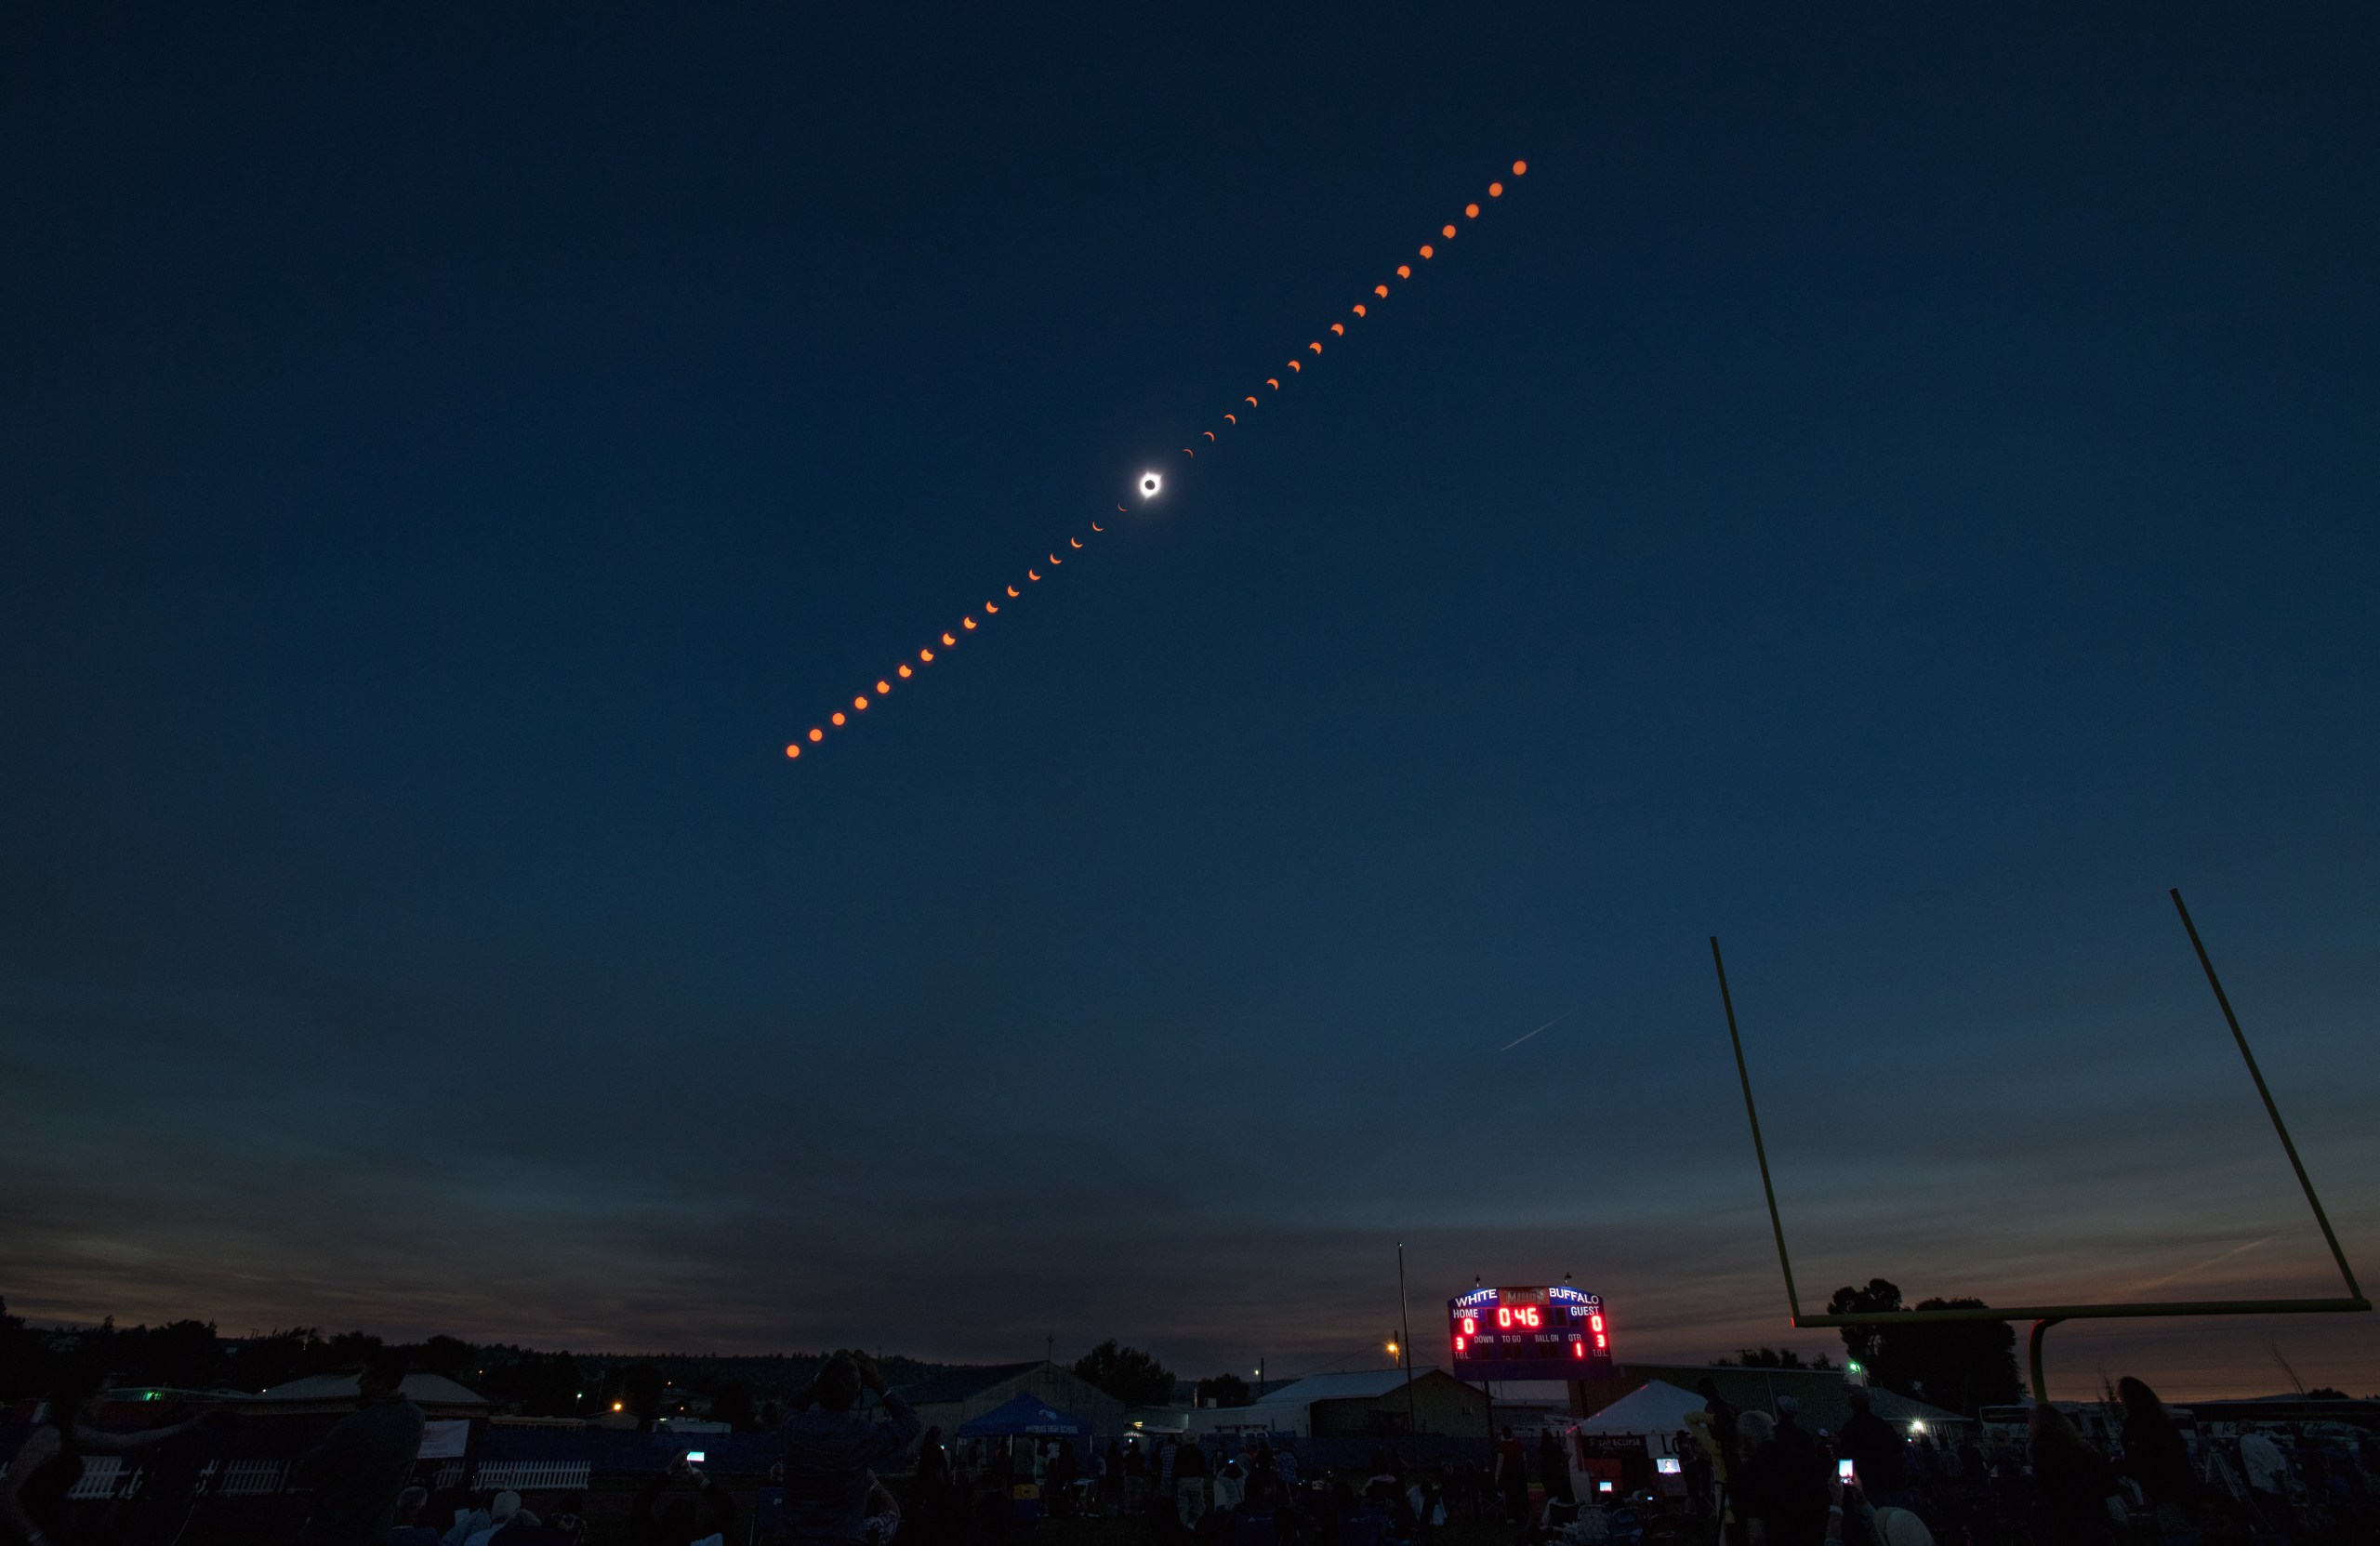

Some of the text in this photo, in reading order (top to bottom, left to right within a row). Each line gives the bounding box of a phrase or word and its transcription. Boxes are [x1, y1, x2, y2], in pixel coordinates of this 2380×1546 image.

[1455, 1288, 1498, 1307] WHITE
[1548, 1288, 1599, 1304] BUFFALO
[1452, 1308, 1479, 1318] HOME
[1570, 1305, 1600, 1316] GUEST
[1464, 1318, 1474, 1333] 0
[1592, 1315, 1602, 1331] 0
[1456, 1337, 1464, 1350] 3
[1474, 1335, 1494, 1344] DOWN
[1501, 1335, 1522, 1343] TO GO
[1535, 1334, 1559, 1342] BALL ON
[1596, 1334, 1606, 1347] 3
[1577, 1343, 1582, 1356] 1
[1613, 1438, 1641, 1447] ECLIPSE
